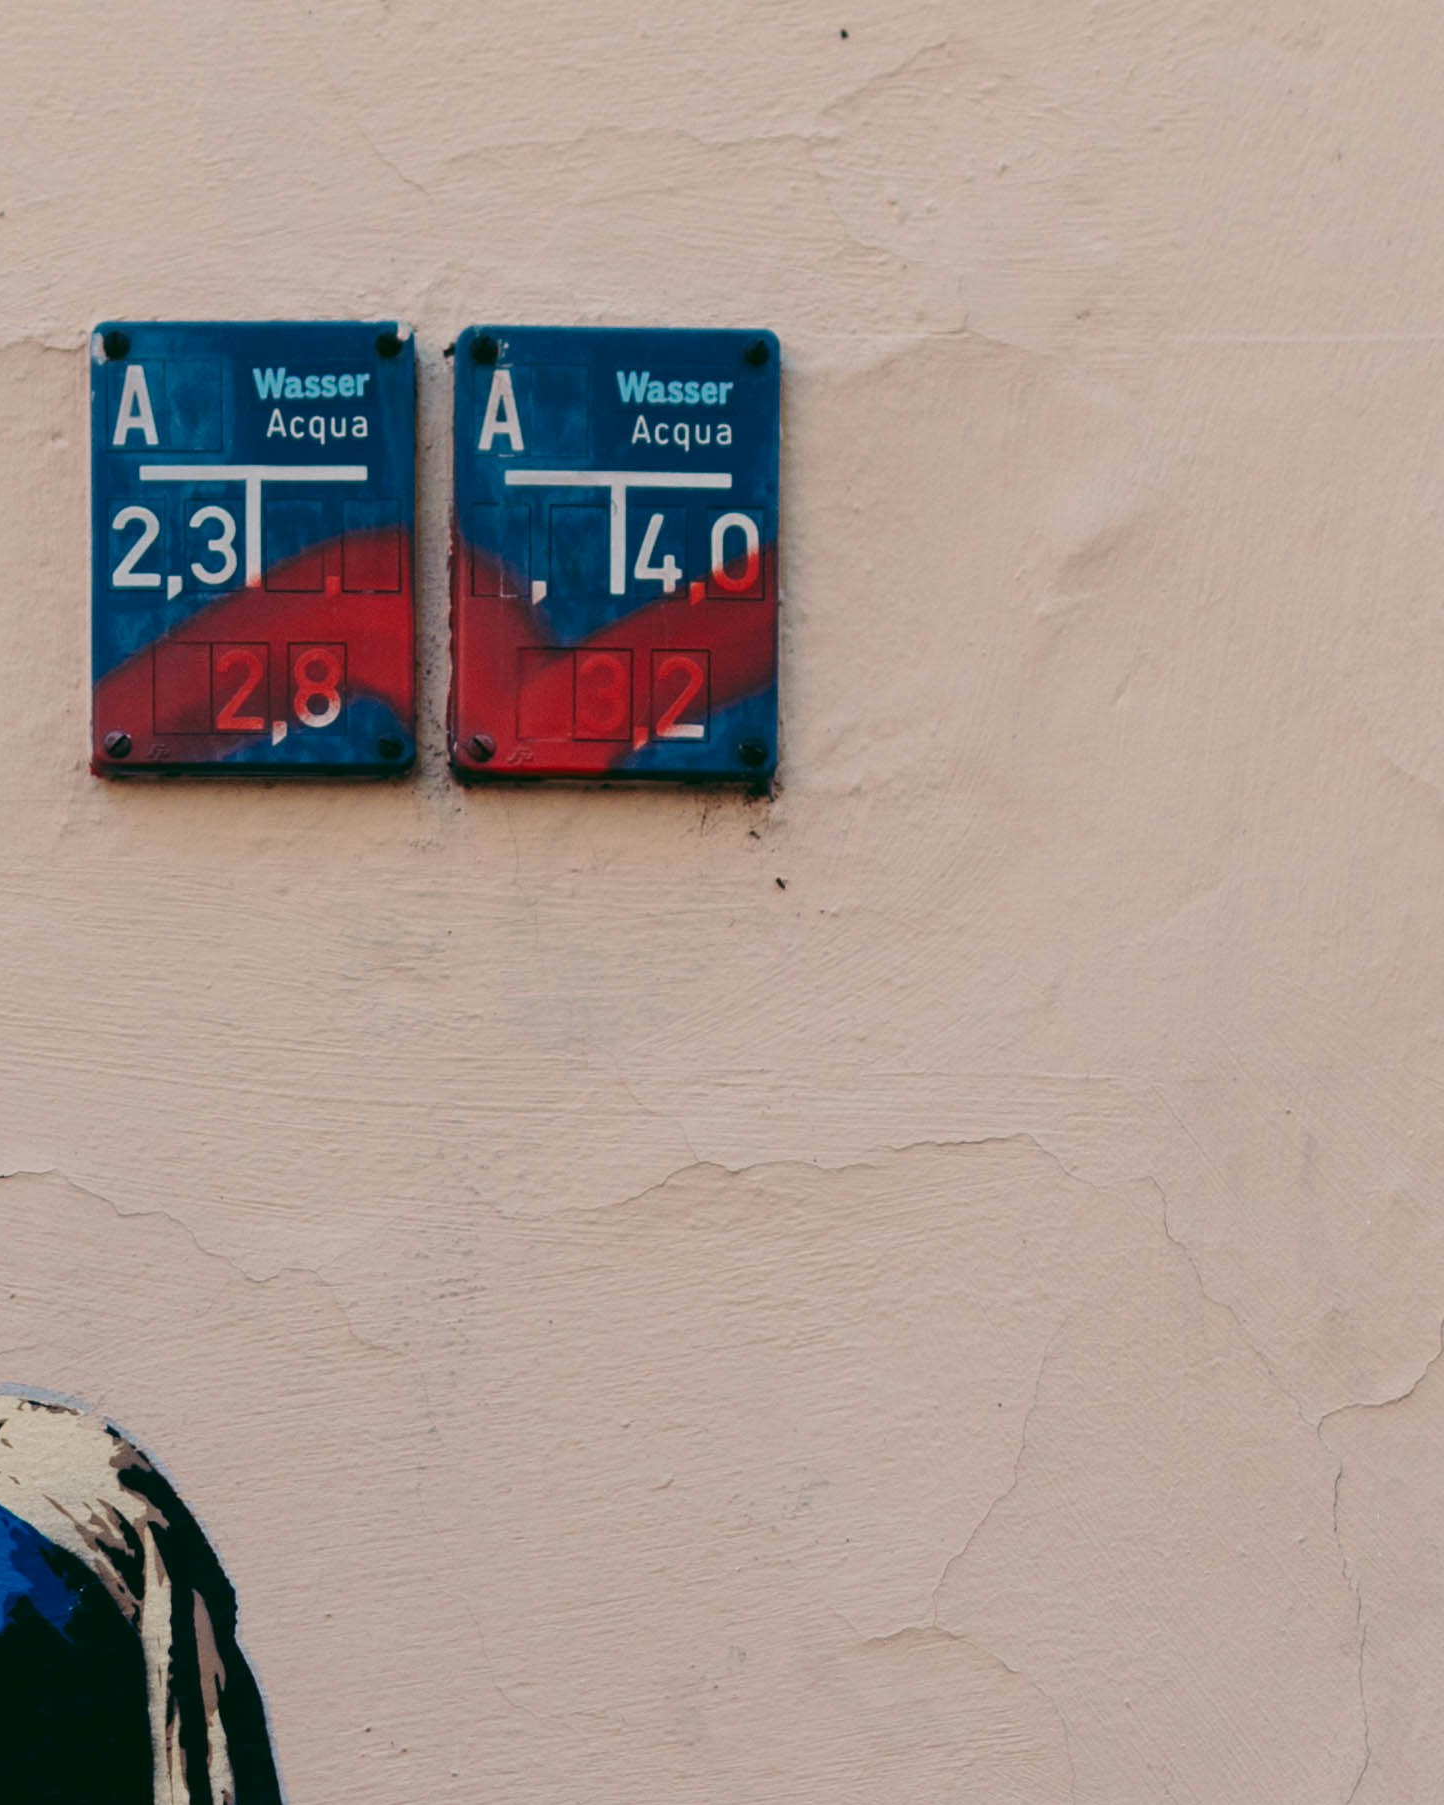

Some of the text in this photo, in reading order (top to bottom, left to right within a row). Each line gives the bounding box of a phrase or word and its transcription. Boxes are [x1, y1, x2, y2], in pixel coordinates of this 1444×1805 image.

[112, 364, 158, 446] A
[253, 367, 370, 400] Wasser
[478, 368, 524, 451] A
[616, 371, 734, 405] Wasser
[266, 408, 369, 445] Acqua
[631, 415, 733, 452] Acqua
[111, 505, 238, 600] 2,3
[633, 512, 760, 606] 4,0
[216, 650, 342, 746] 2,8
